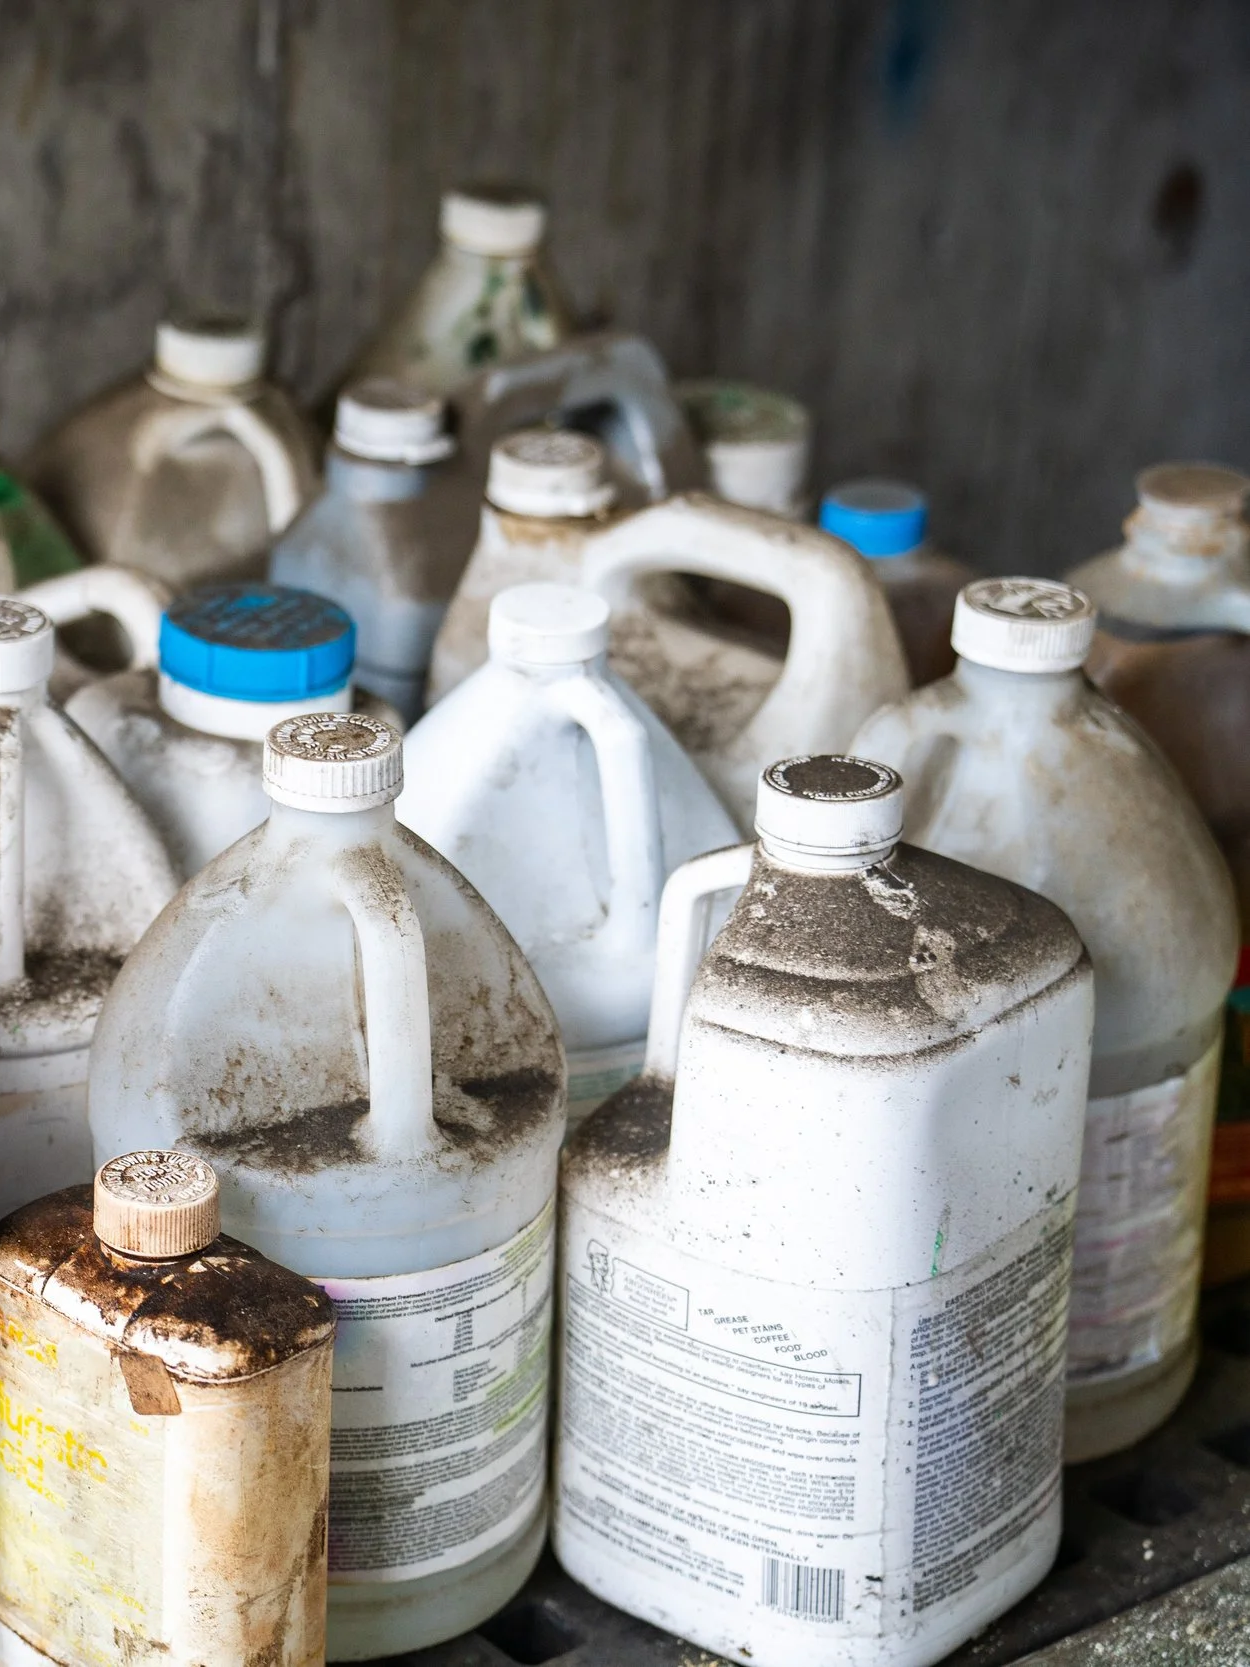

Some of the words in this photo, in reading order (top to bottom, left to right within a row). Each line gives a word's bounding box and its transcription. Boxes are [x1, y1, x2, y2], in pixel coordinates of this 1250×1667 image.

[698, 1308, 714, 1316] TAR
[714, 1315, 749, 1325] GREASE
[733, 1327, 749, 1335] PET
[751, 1323, 783, 1334] STAINS
[754, 1333, 790, 1344] COFFEE
[775, 1344, 801, 1354] FOOD
[794, 1349, 828, 1362] BLOOD
